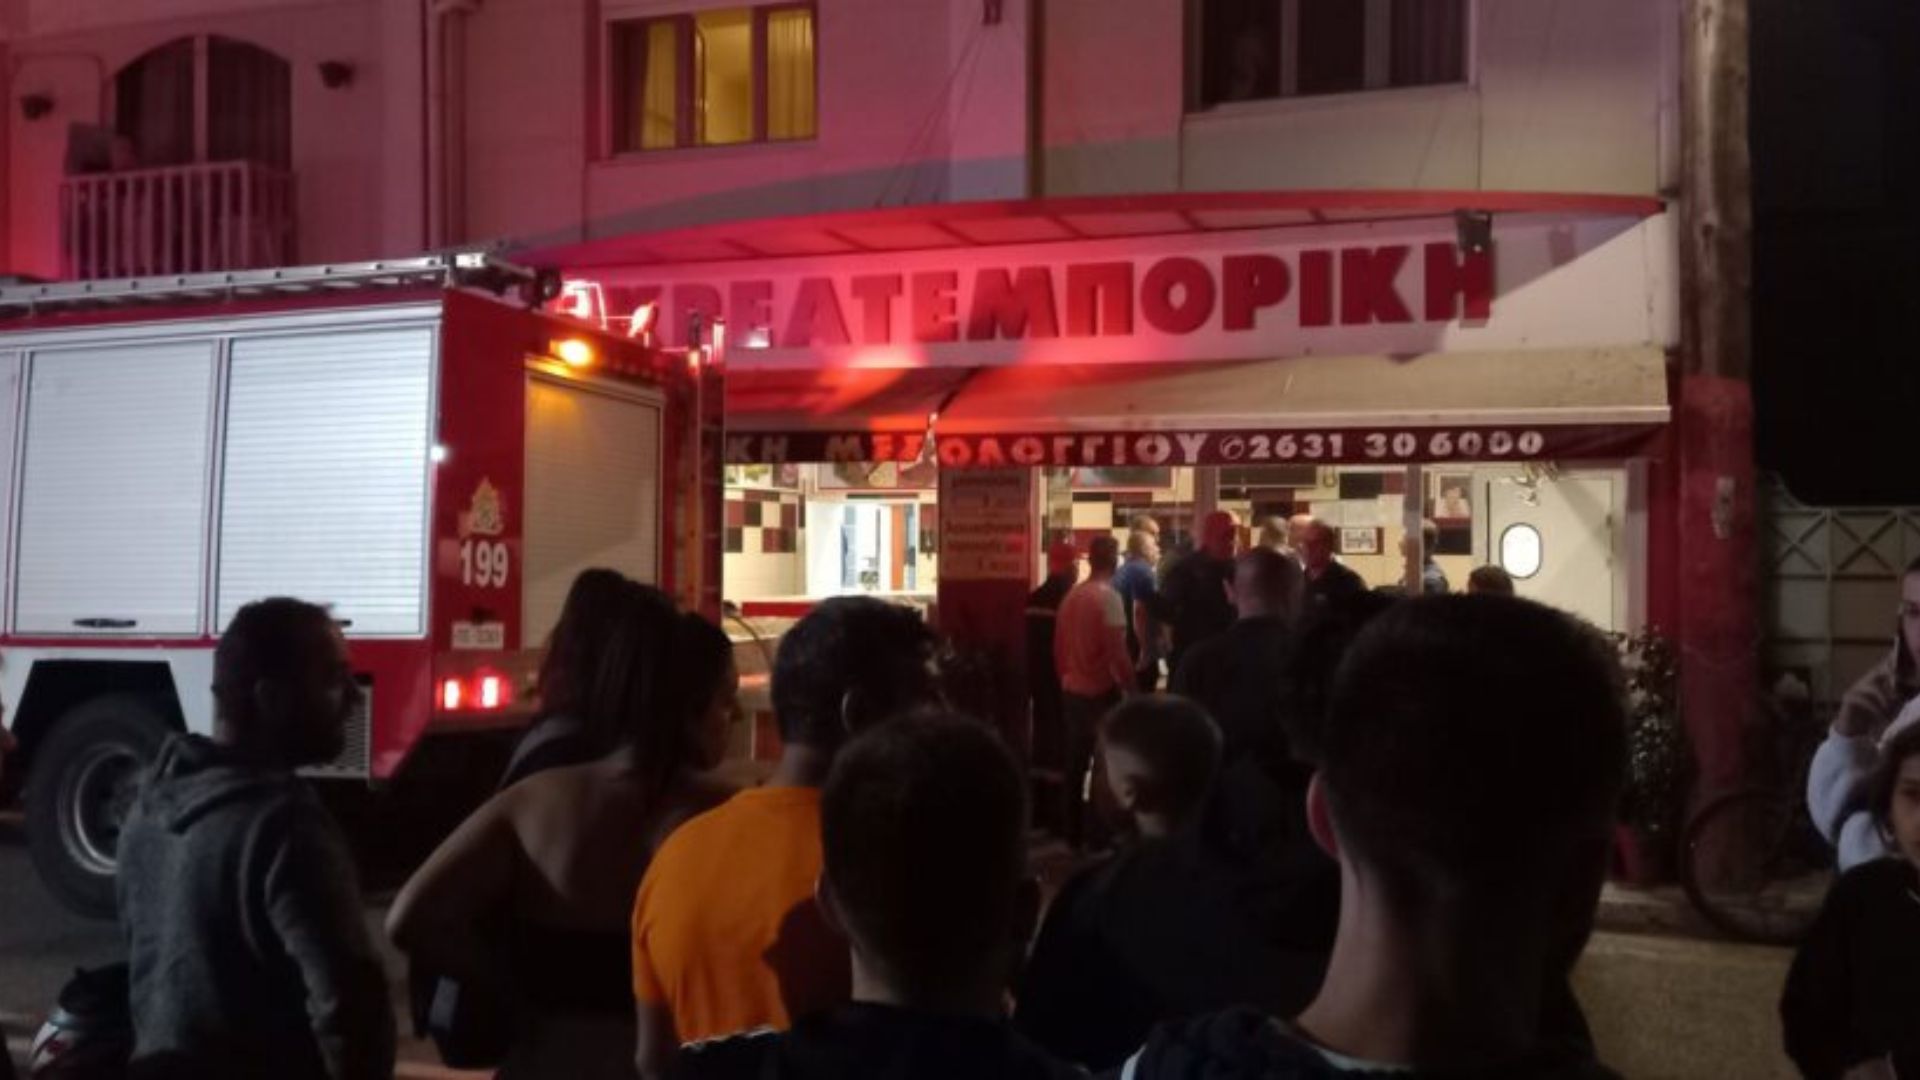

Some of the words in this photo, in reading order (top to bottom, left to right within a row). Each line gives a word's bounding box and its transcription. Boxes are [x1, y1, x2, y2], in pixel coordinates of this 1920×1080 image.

[726, 435, 788, 463] ΚΗ
[1250, 433, 1343, 458] 2631
[1365, 433, 1416, 457] 30
[1430, 430, 1544, 456] 6000
[460, 541, 508, 587] 199
